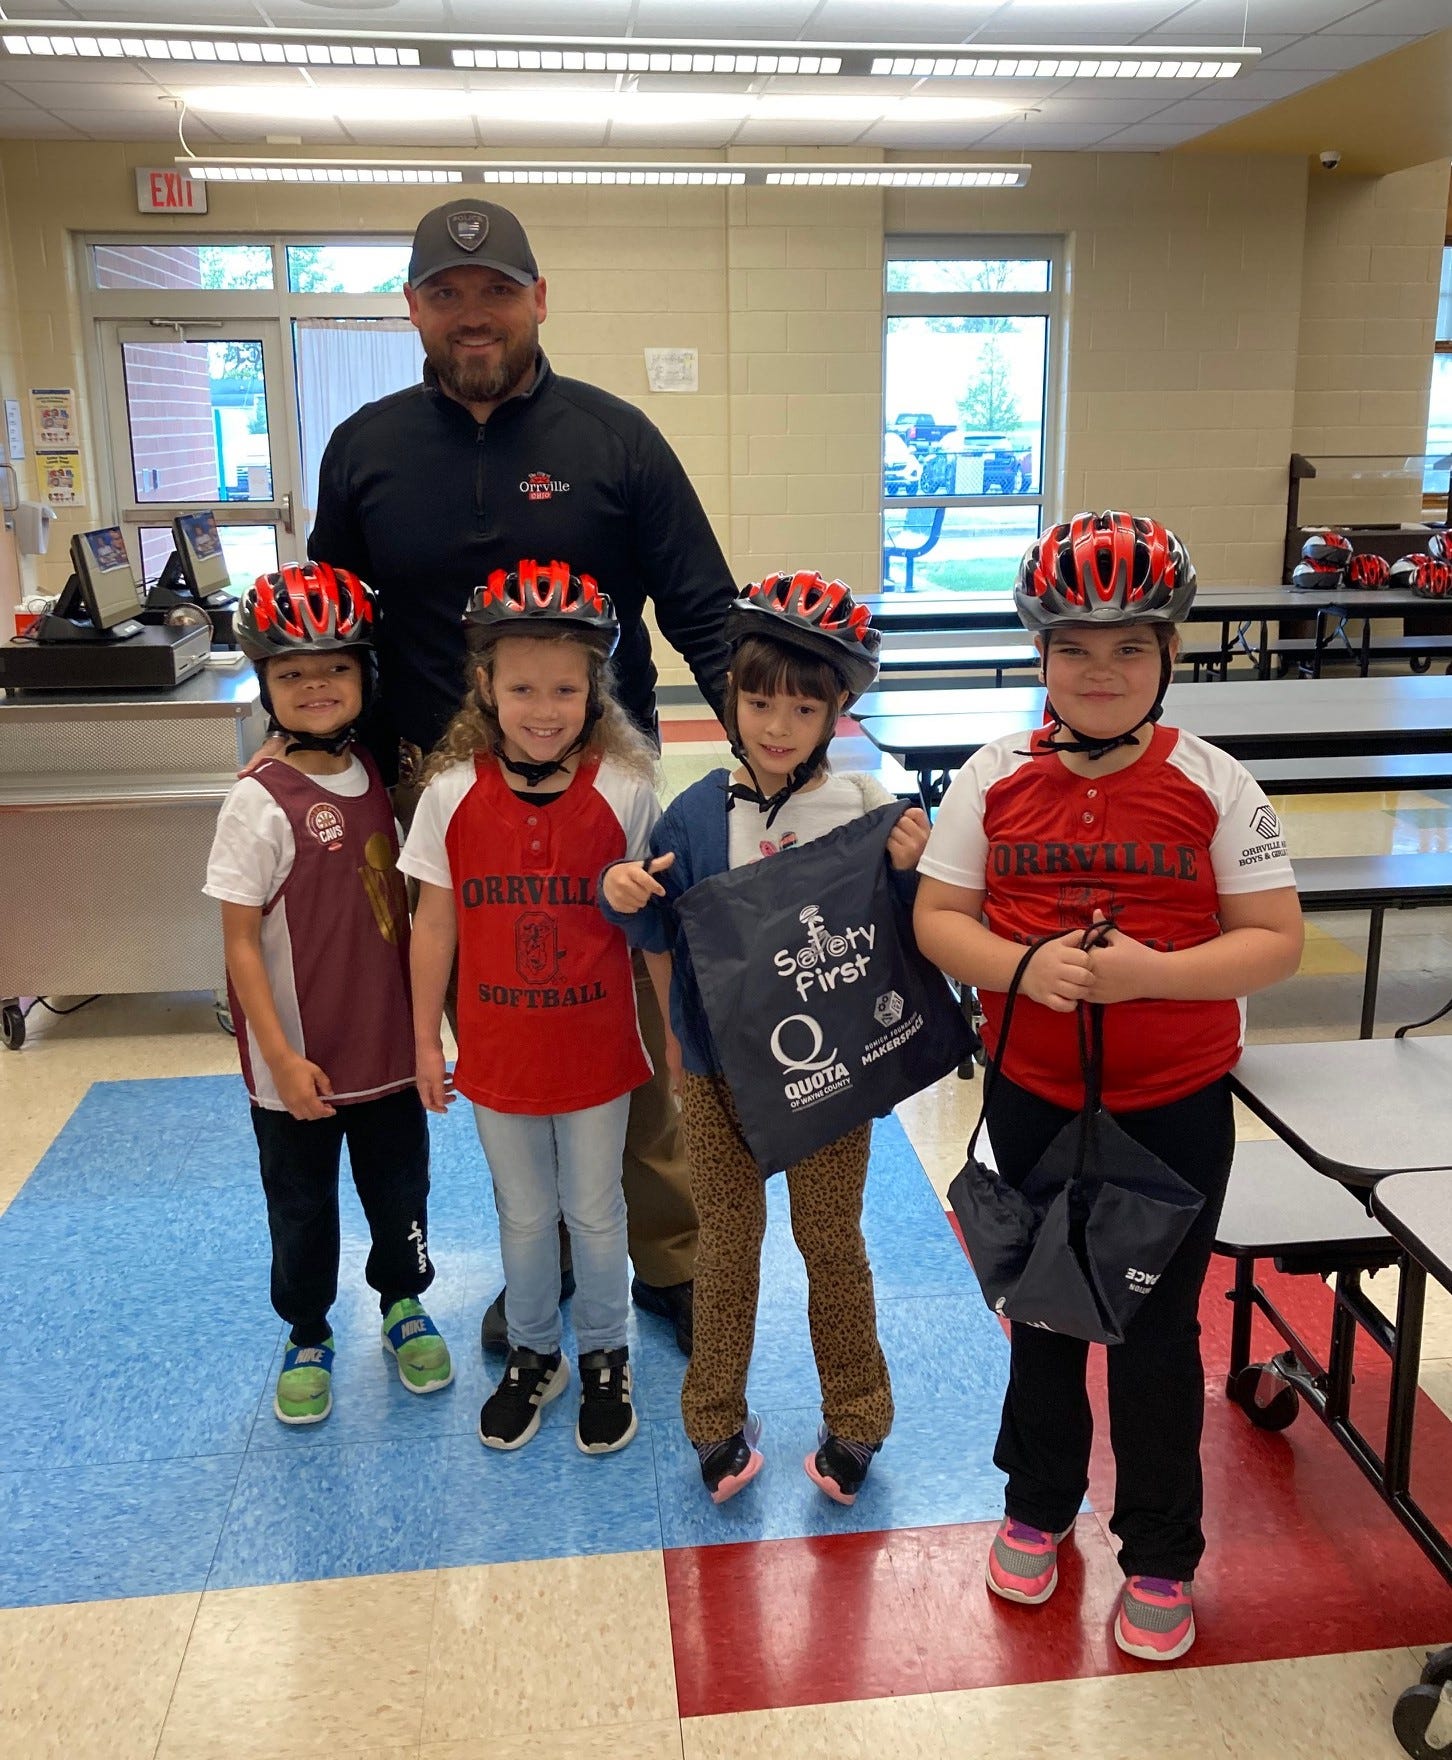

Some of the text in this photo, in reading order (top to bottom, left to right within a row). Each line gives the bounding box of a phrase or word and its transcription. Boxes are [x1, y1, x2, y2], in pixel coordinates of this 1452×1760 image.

[150, 173, 193, 207] EXIT
[519, 481, 570, 493] Orrville
[319, 825, 344, 843] CAVS
[1242, 841, 1280, 858] ORRVILLE
[994, 842, 1198, 881] ORRVILLE
[1239, 854, 1263, 867] BOYS
[462, 875, 596, 909] ORRVILL
[774, 915, 876, 977] Safety
[478, 981, 607, 1009] SOFTBALL
[770, 1013, 838, 1076] Q
[861, 1014, 924, 1066] MAKERSPACE
[784, 1062, 850, 1100] QUOTA
[790, 1077, 851, 1109] OF WAYNE COUNTY
[401, 1319, 427, 1339] NIKE
[294, 1347, 326, 1365] NIKE
